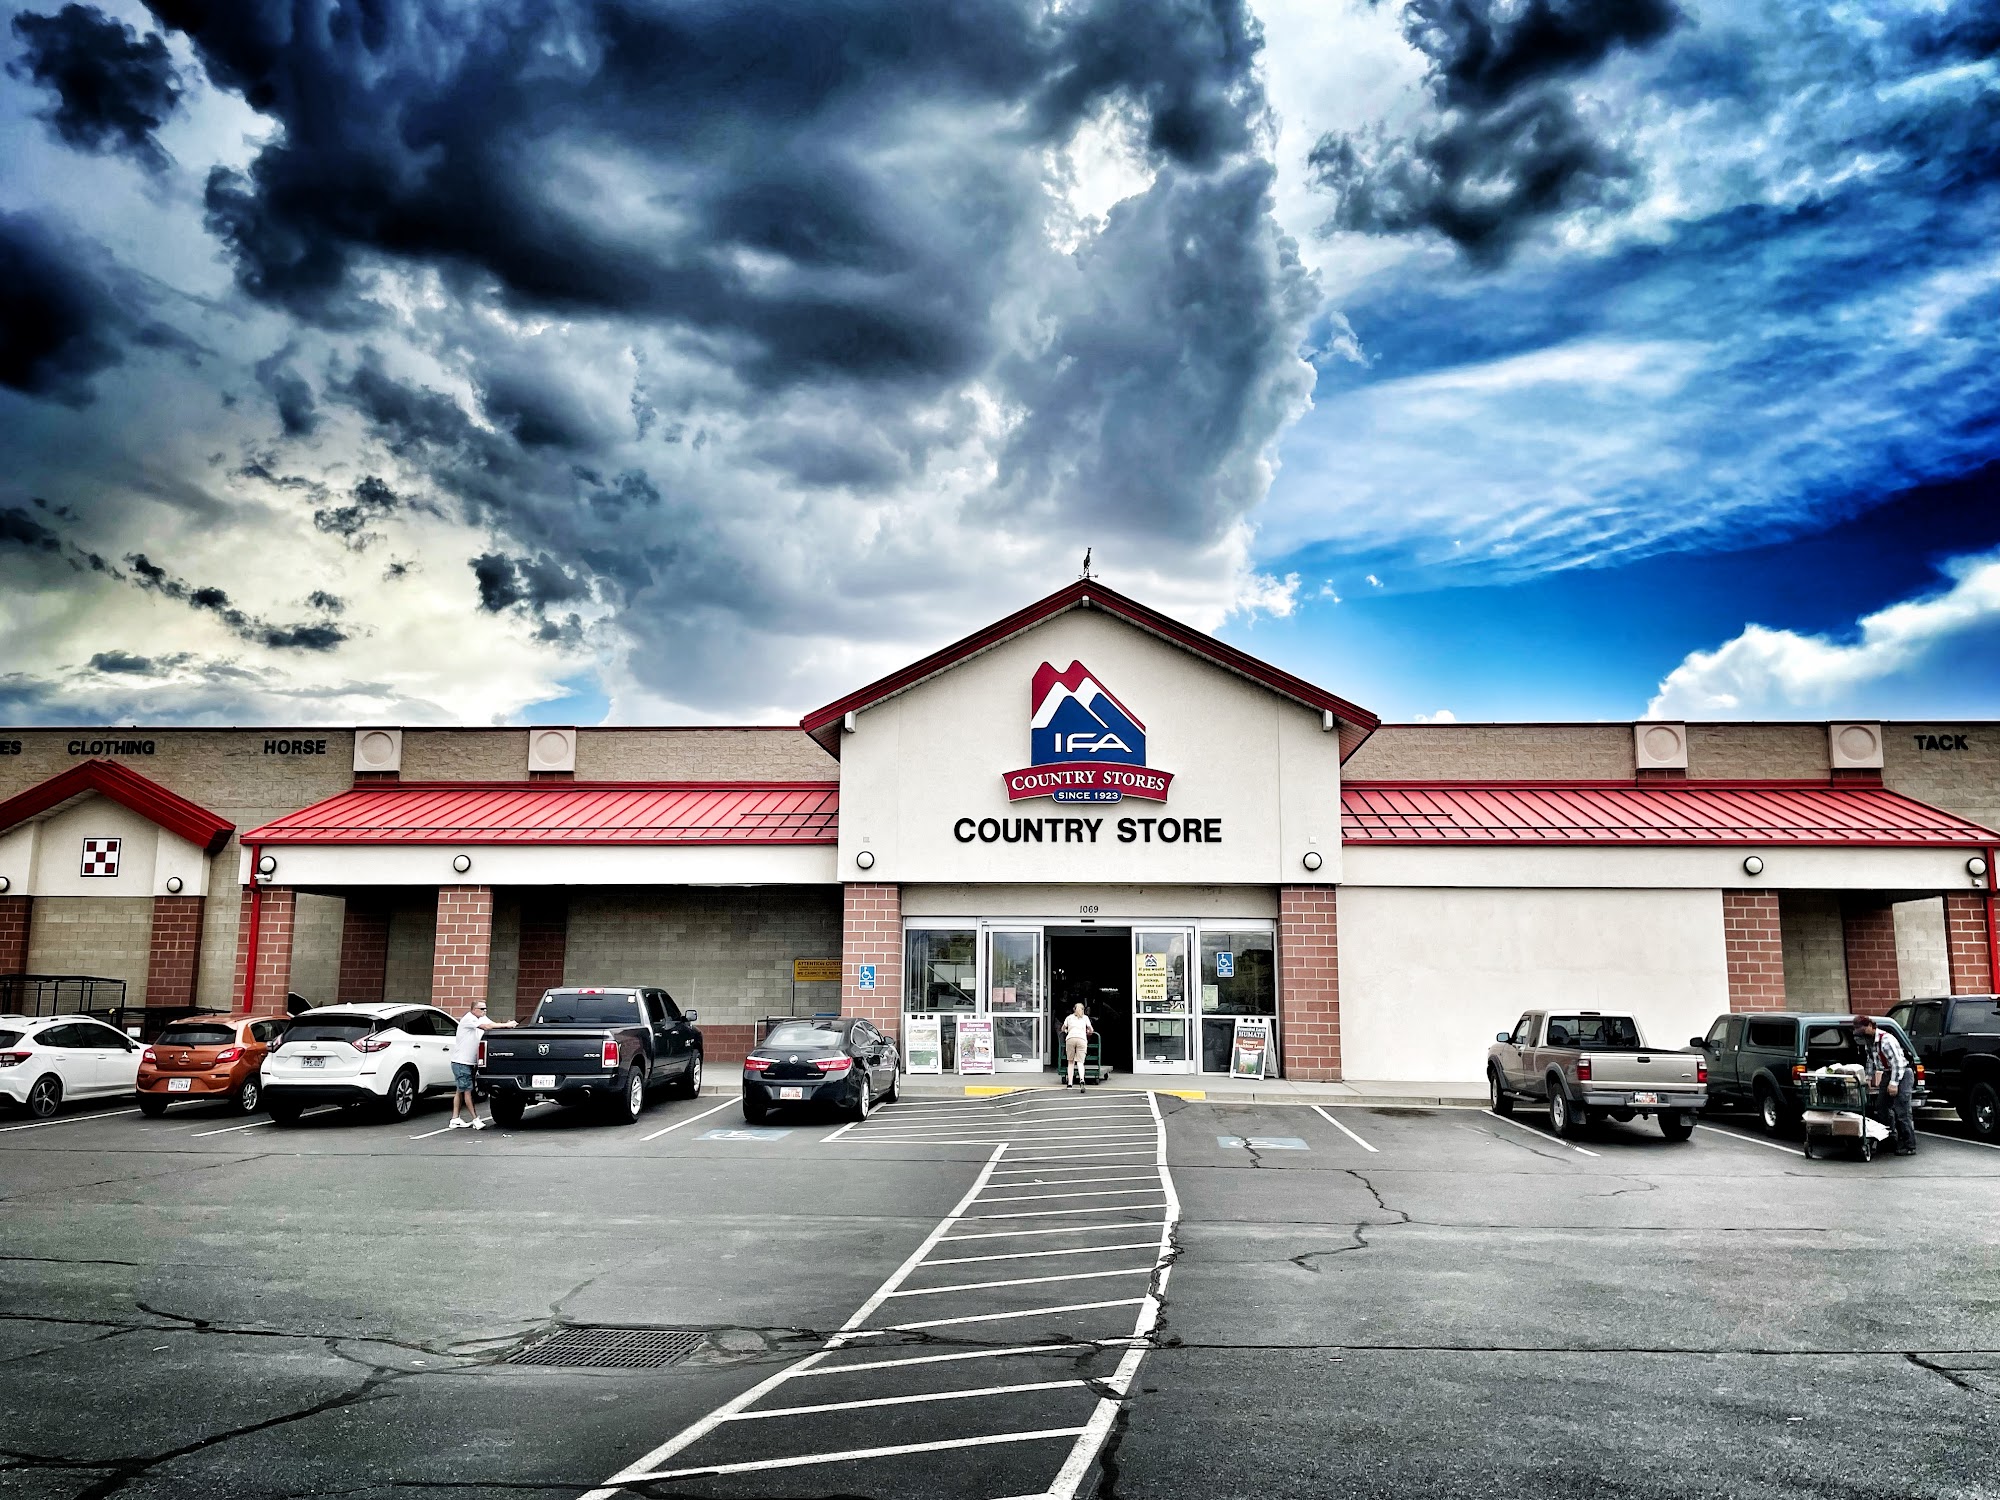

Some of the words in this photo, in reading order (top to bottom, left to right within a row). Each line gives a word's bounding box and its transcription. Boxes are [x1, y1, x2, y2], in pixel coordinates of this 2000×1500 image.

[67, 740, 155, 755] CLOTHING
[263, 739, 327, 755] HORSE
[1054, 732, 1133, 753] IFA
[1913, 734, 1969, 750] TACK
[1011, 770, 1096, 791] COUNTRY
[1102, 771, 1166, 791] STORES
[1058, 791, 1091, 800] SINCE
[1093, 791, 1119, 800] 1923
[953, 818, 1103, 843] COUNTRY
[1117, 818, 1222, 843] STORE
[1079, 905, 1099, 913] 1069
